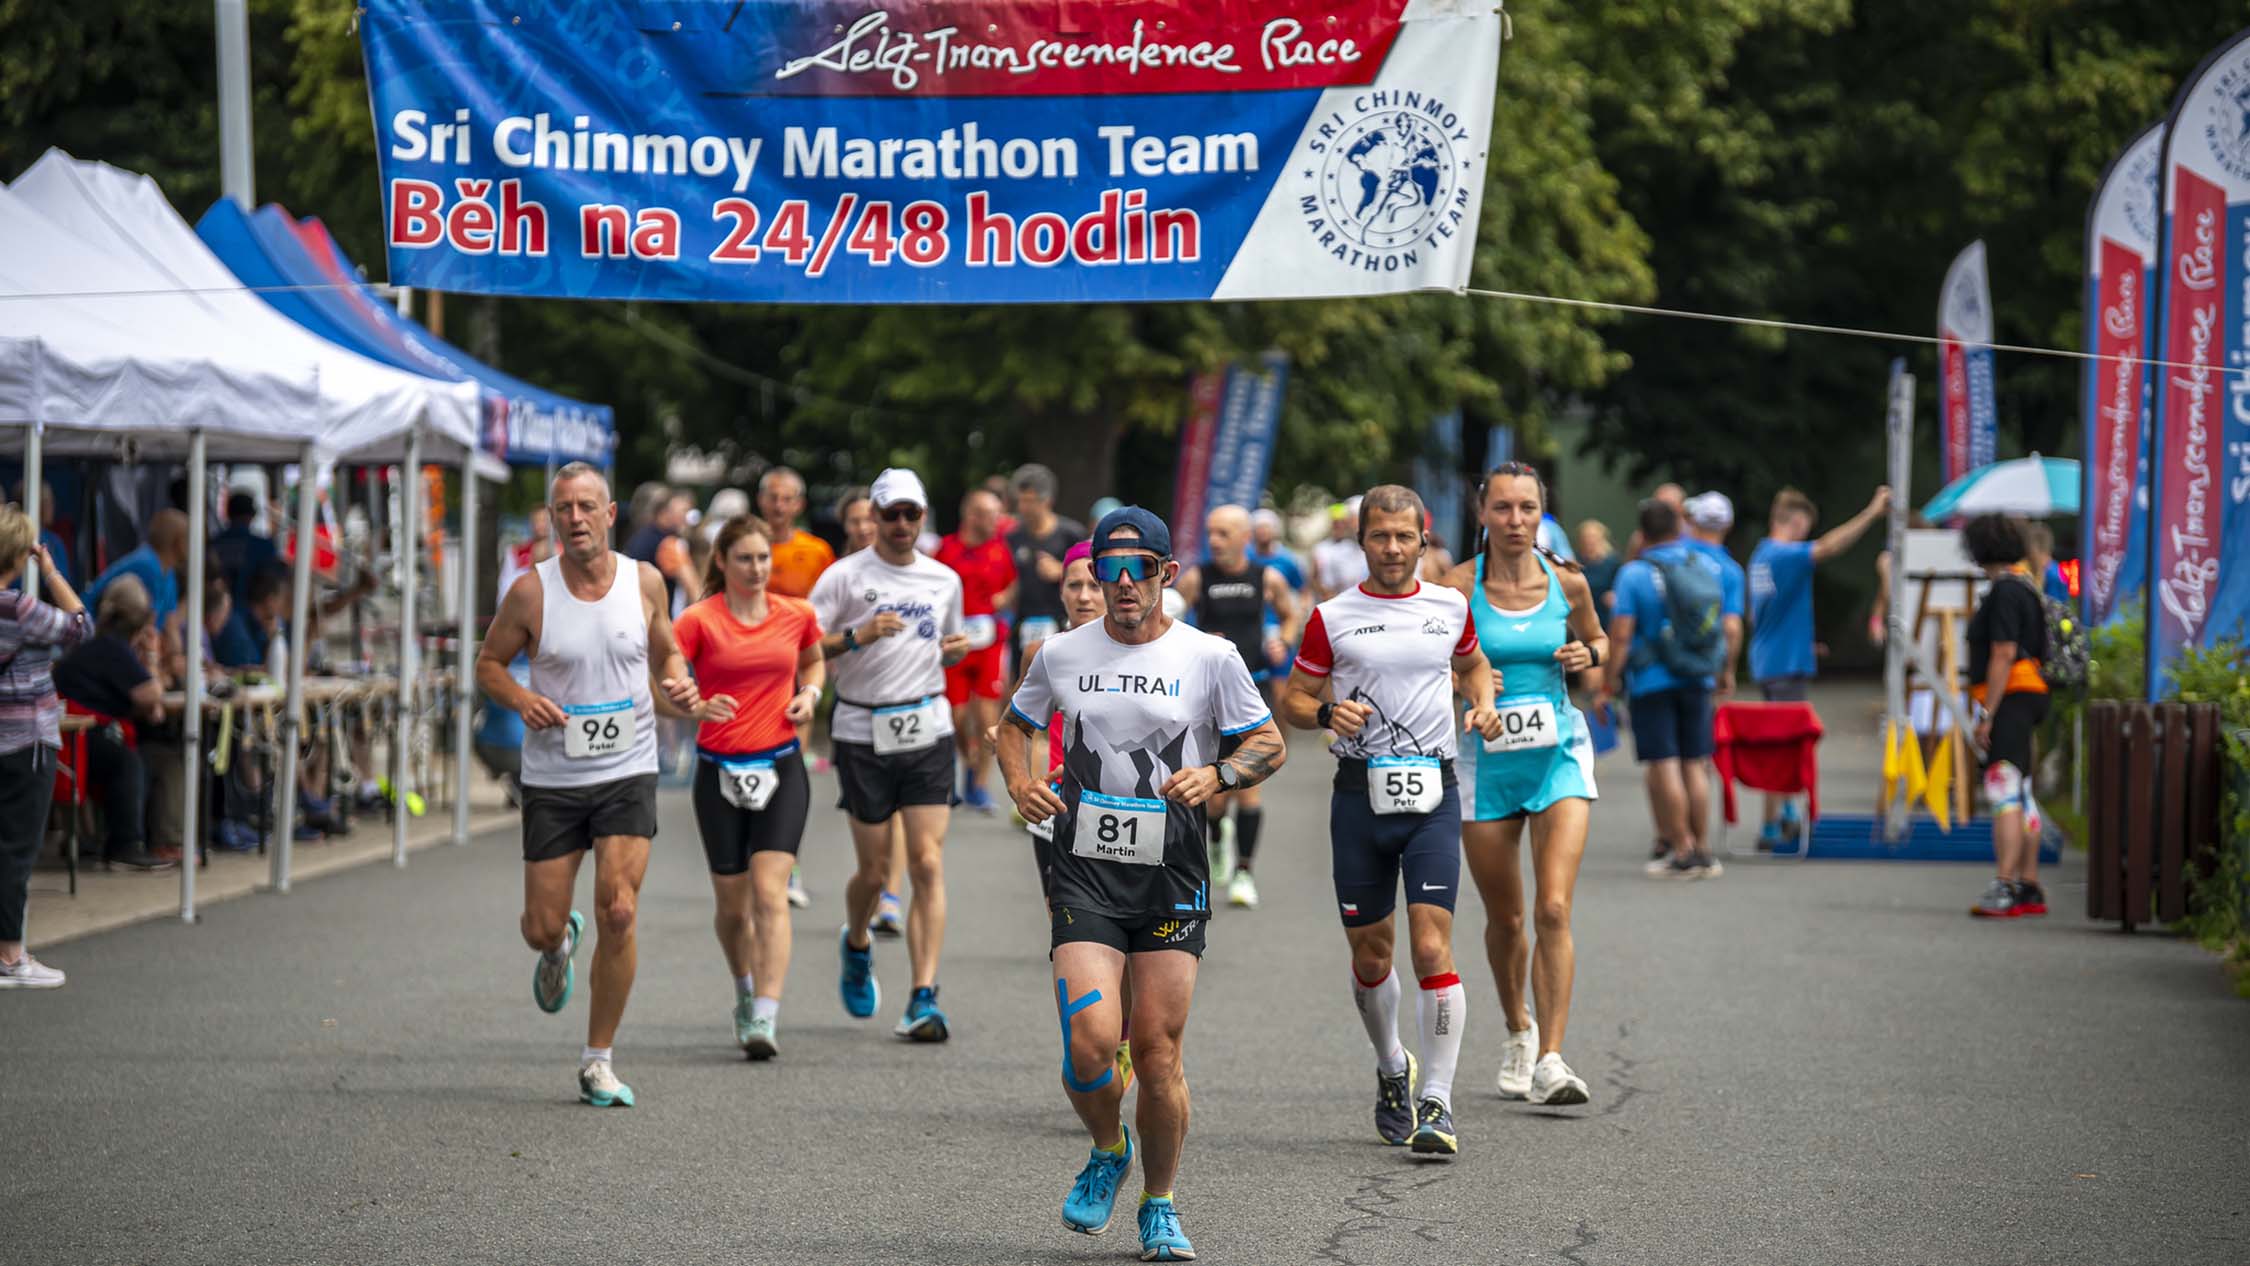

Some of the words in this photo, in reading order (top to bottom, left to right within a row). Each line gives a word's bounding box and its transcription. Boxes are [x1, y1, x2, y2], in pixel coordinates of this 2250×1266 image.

[1261, 17, 1361, 71] Race
[1310, 112, 1345, 153] SRI
[1354, 90, 1469, 143] CHINMOY
[392, 108, 470, 164] Sri
[493, 113, 762, 192] Chinmoy
[783, 122, 1078, 179] Marathon
[1098, 126, 1259, 177] Team
[389, 178, 549, 257] Běh
[580, 202, 681, 261] na
[709, 192, 949, 278] 24/48
[965, 188, 1200, 267] hodin
[1301, 194, 1417, 272] MARATHON
[1426, 188, 1469, 249] TEAM
[2179, 208, 2216, 290] Race
[1354, 624, 1385, 635] ATEX
[583, 717, 619, 741] 96
[889, 714, 921, 736] 92
[1498, 709, 1544, 734] 04
[1386, 772, 1423, 796] 55
[1394, 798, 1416, 806] Petr
[1097, 814, 1138, 845] 81
[1096, 843, 1135, 857] Martin
